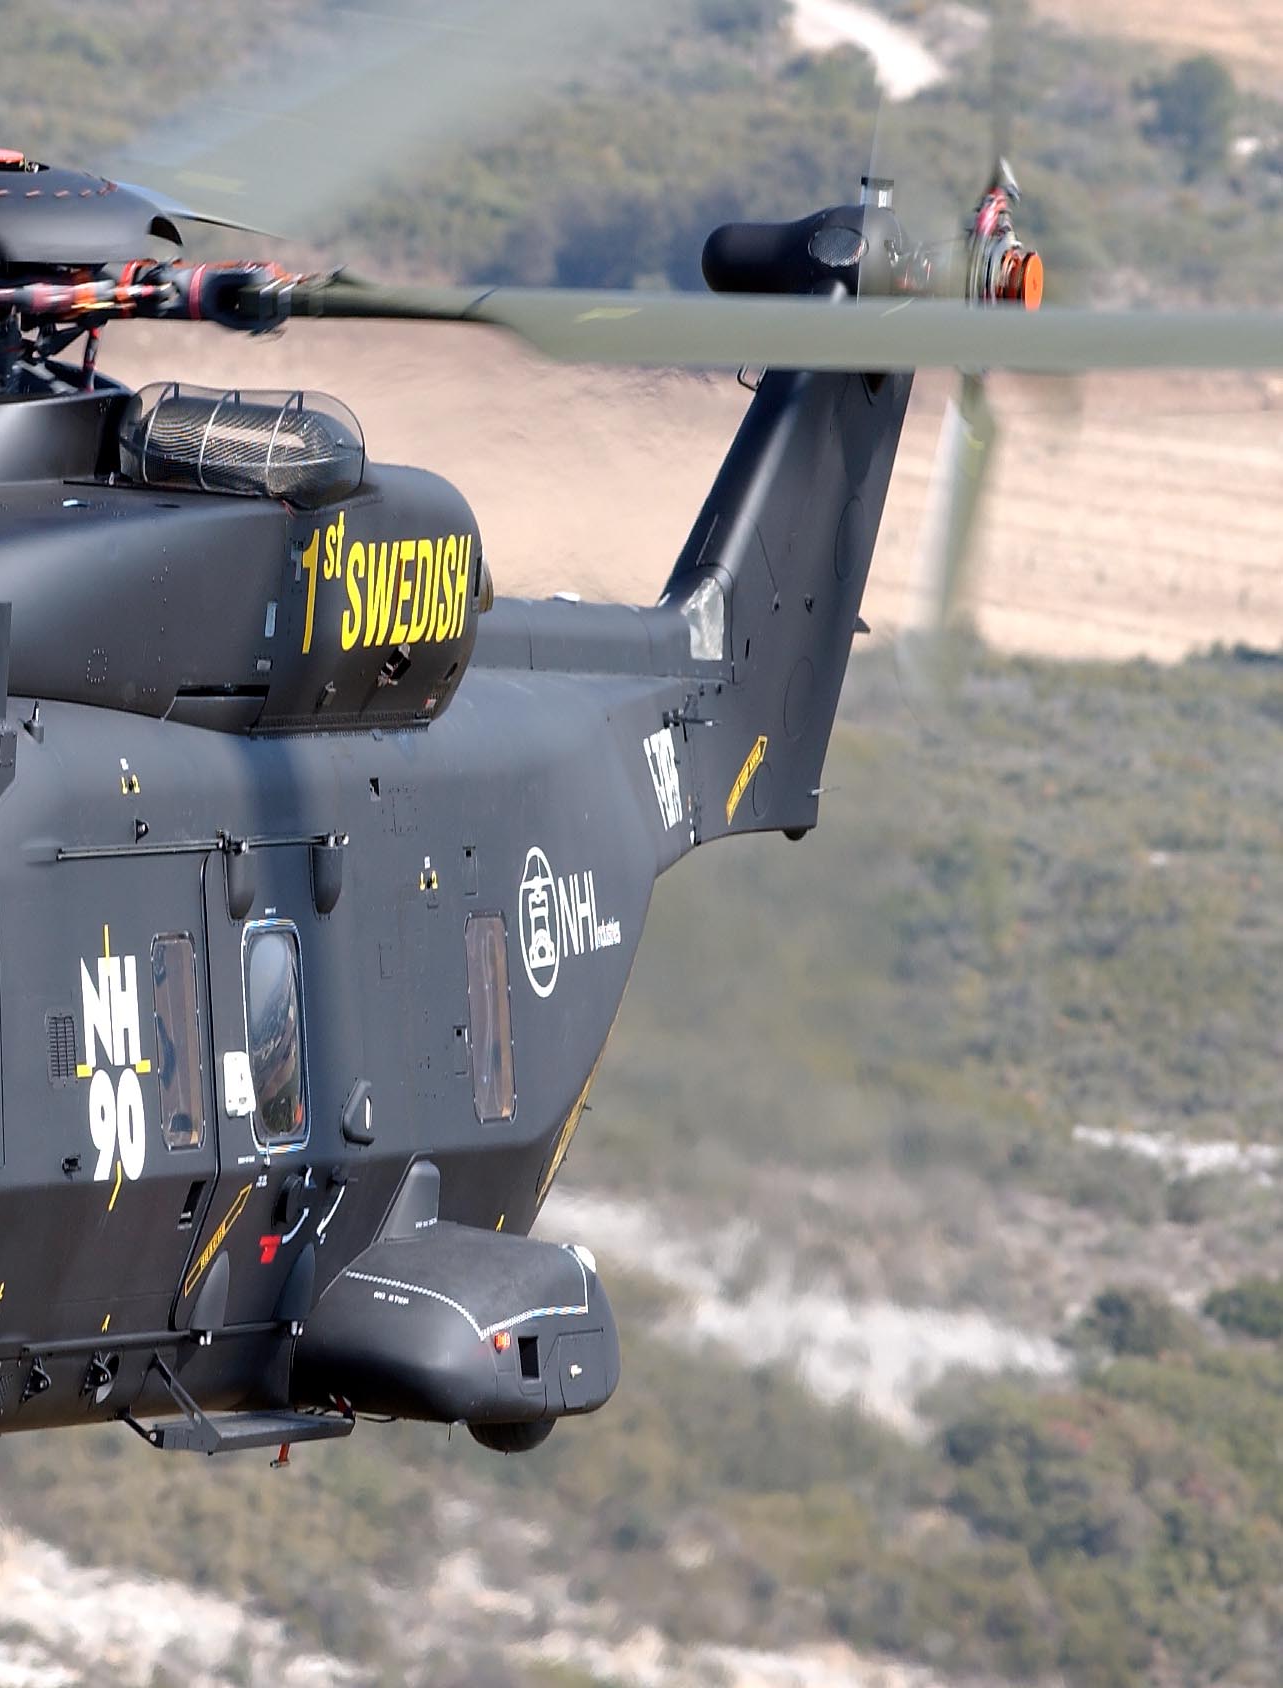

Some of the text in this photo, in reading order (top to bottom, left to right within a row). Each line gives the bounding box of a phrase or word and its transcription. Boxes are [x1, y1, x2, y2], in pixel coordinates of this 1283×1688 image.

[302, 510, 472, 654] 1st SWEDISH
[80, 954, 142, 1068] NH
[88, 1067, 146, 1182] 90
